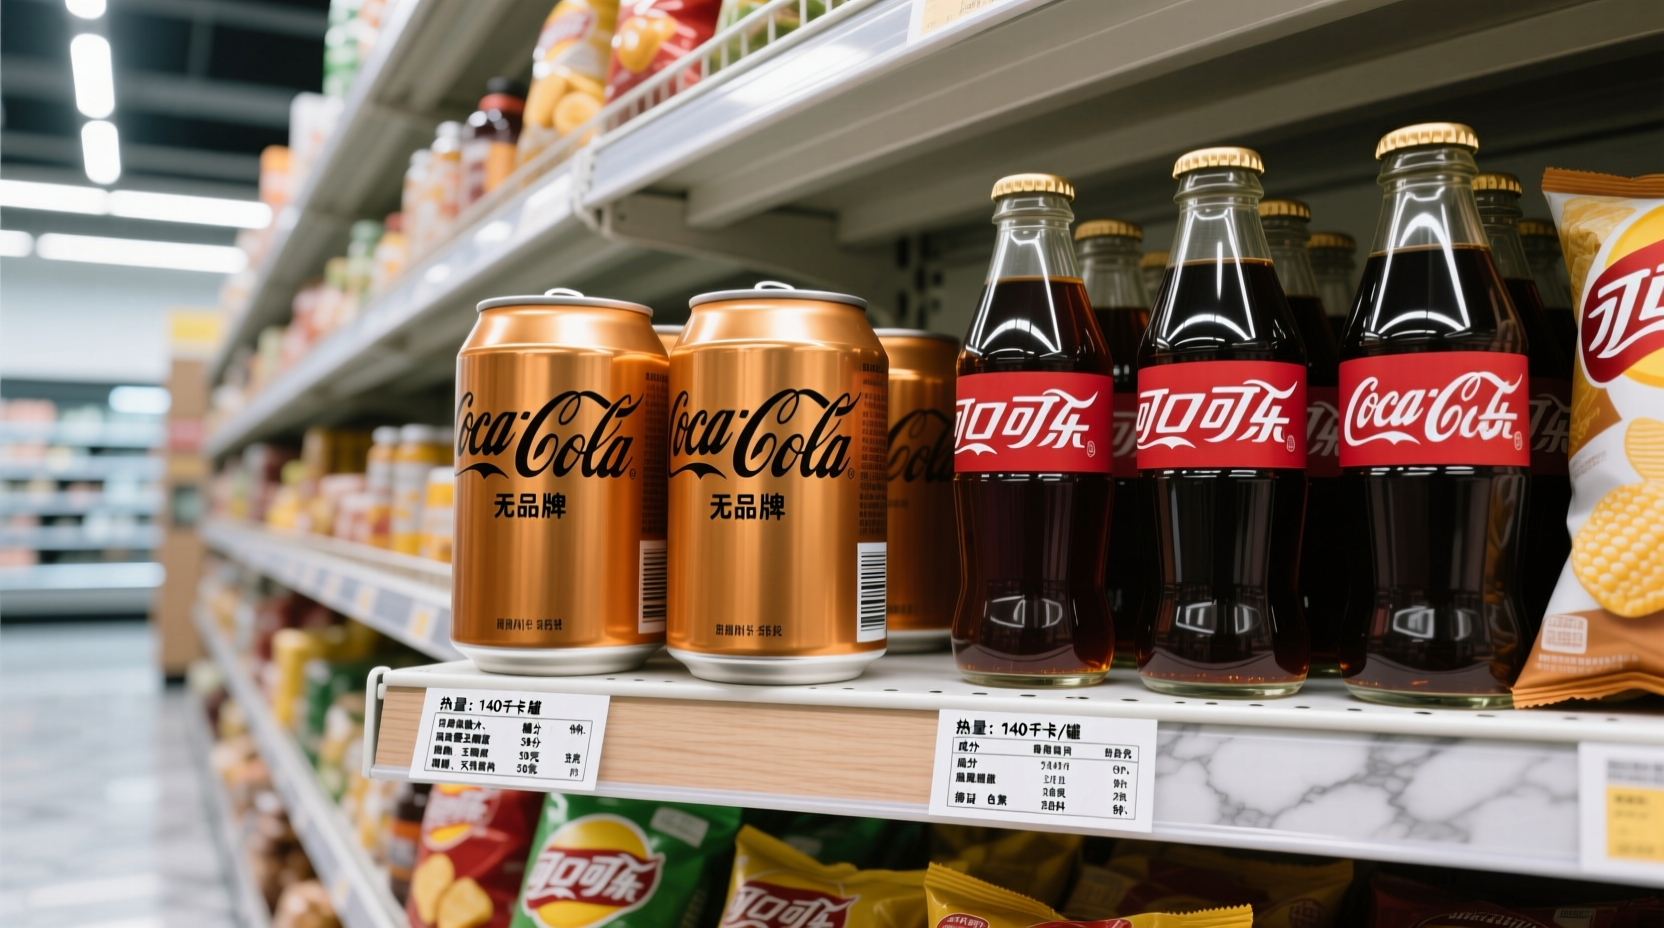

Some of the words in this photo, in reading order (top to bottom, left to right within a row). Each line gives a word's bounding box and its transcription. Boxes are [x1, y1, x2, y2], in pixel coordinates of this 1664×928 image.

[493, 492, 567, 519] 无品牌
[709, 492, 786, 521] 无品牌
